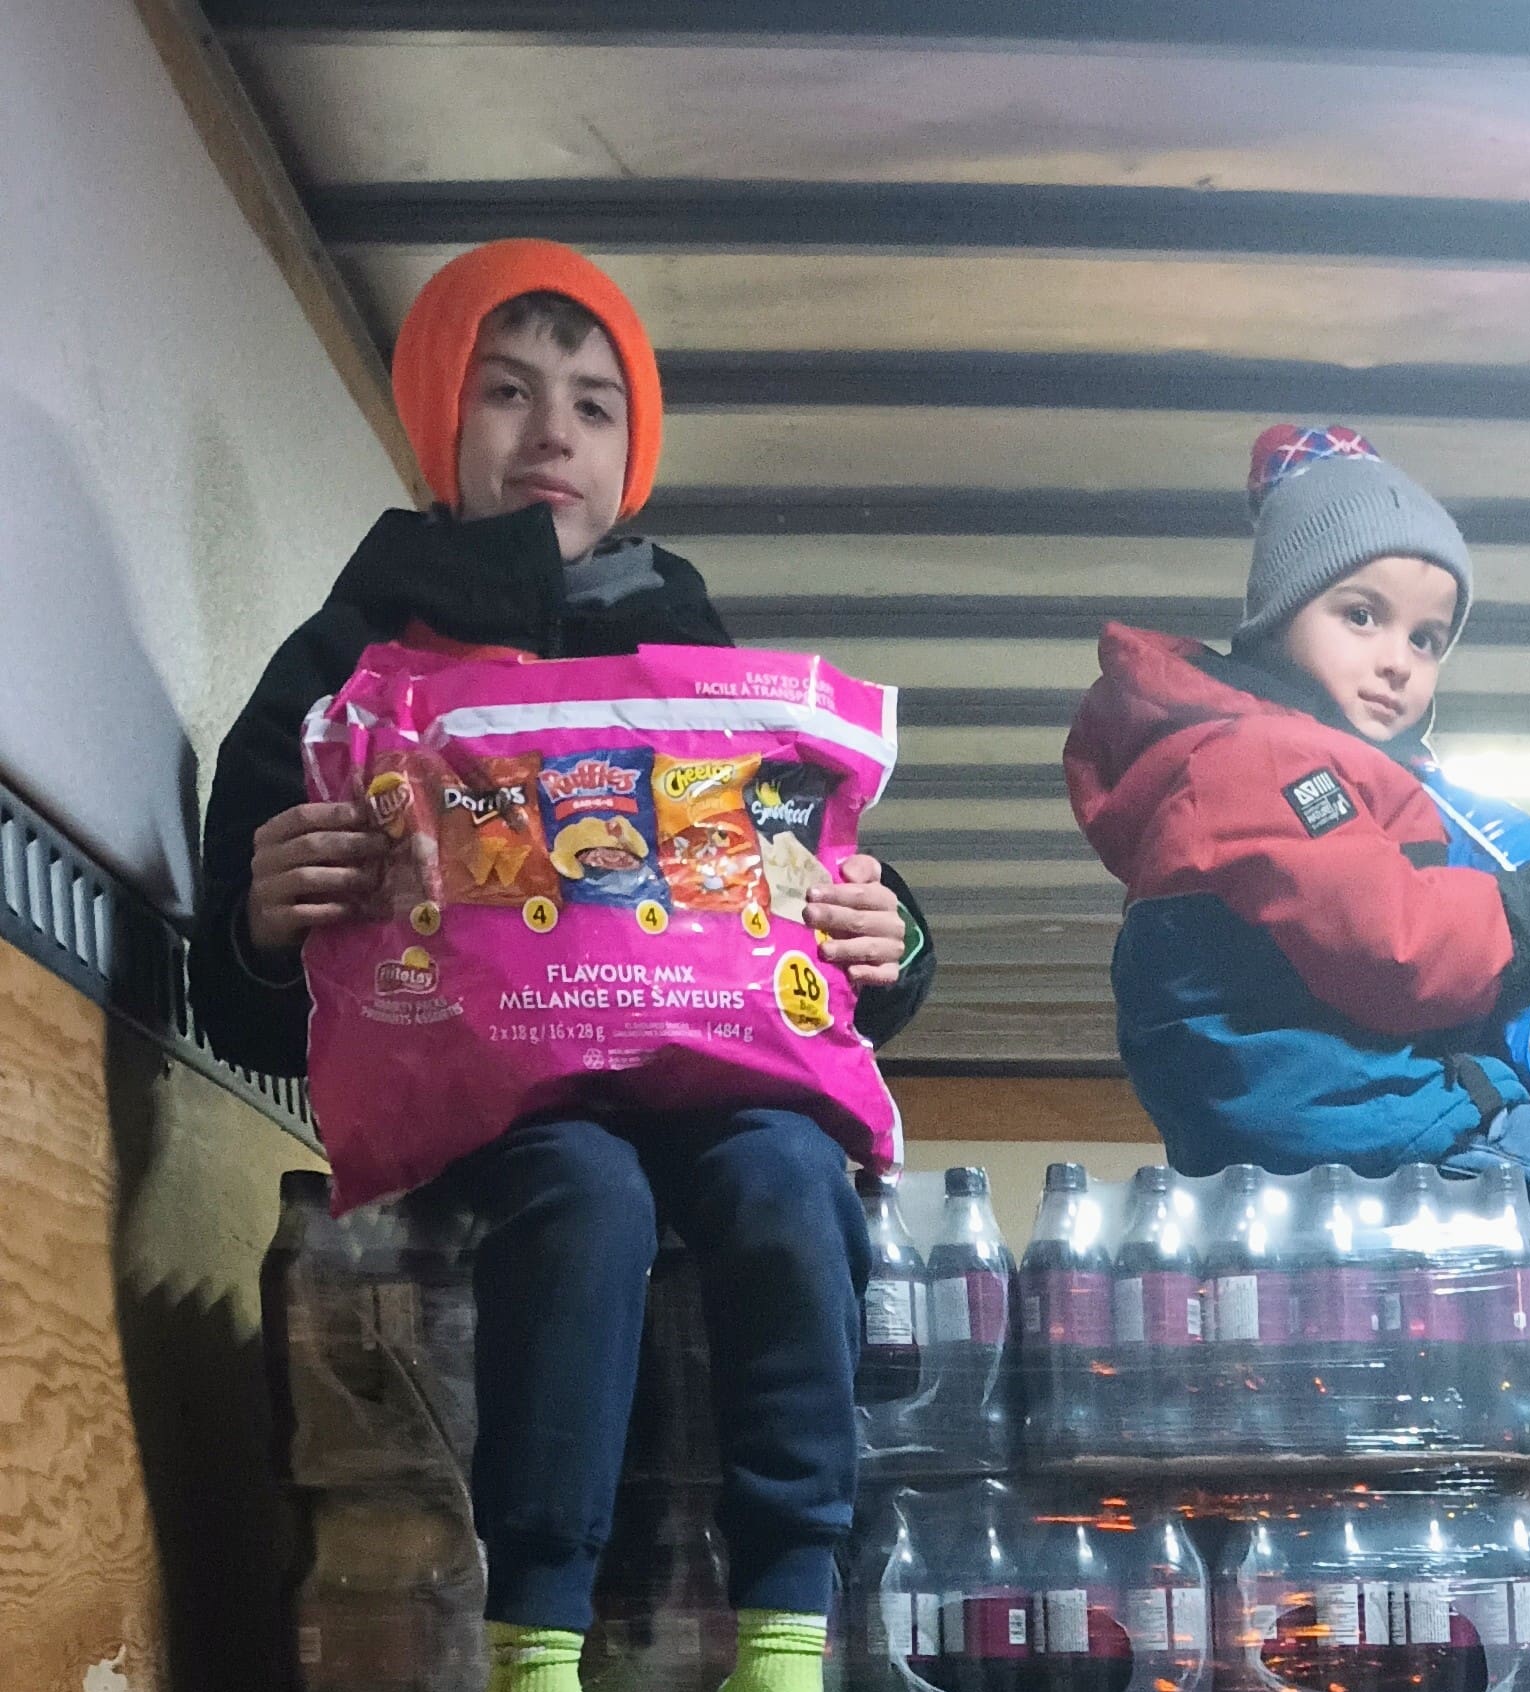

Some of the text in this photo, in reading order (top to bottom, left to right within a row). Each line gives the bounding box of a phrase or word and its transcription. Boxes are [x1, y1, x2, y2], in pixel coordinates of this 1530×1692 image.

[695, 682, 738, 696] FACILE
[533, 904, 547, 925] 4
[645, 907, 658, 931] 4
[547, 964, 696, 984] FLAVOUR MIX
[790, 963, 820, 1001] 18
[499, 985, 745, 1011] MÉLANGE DE SAVEURS
[549, 1024, 565, 1040] 16
[576, 1023, 594, 1039] 28
[714, 1023, 740, 1038] 484
